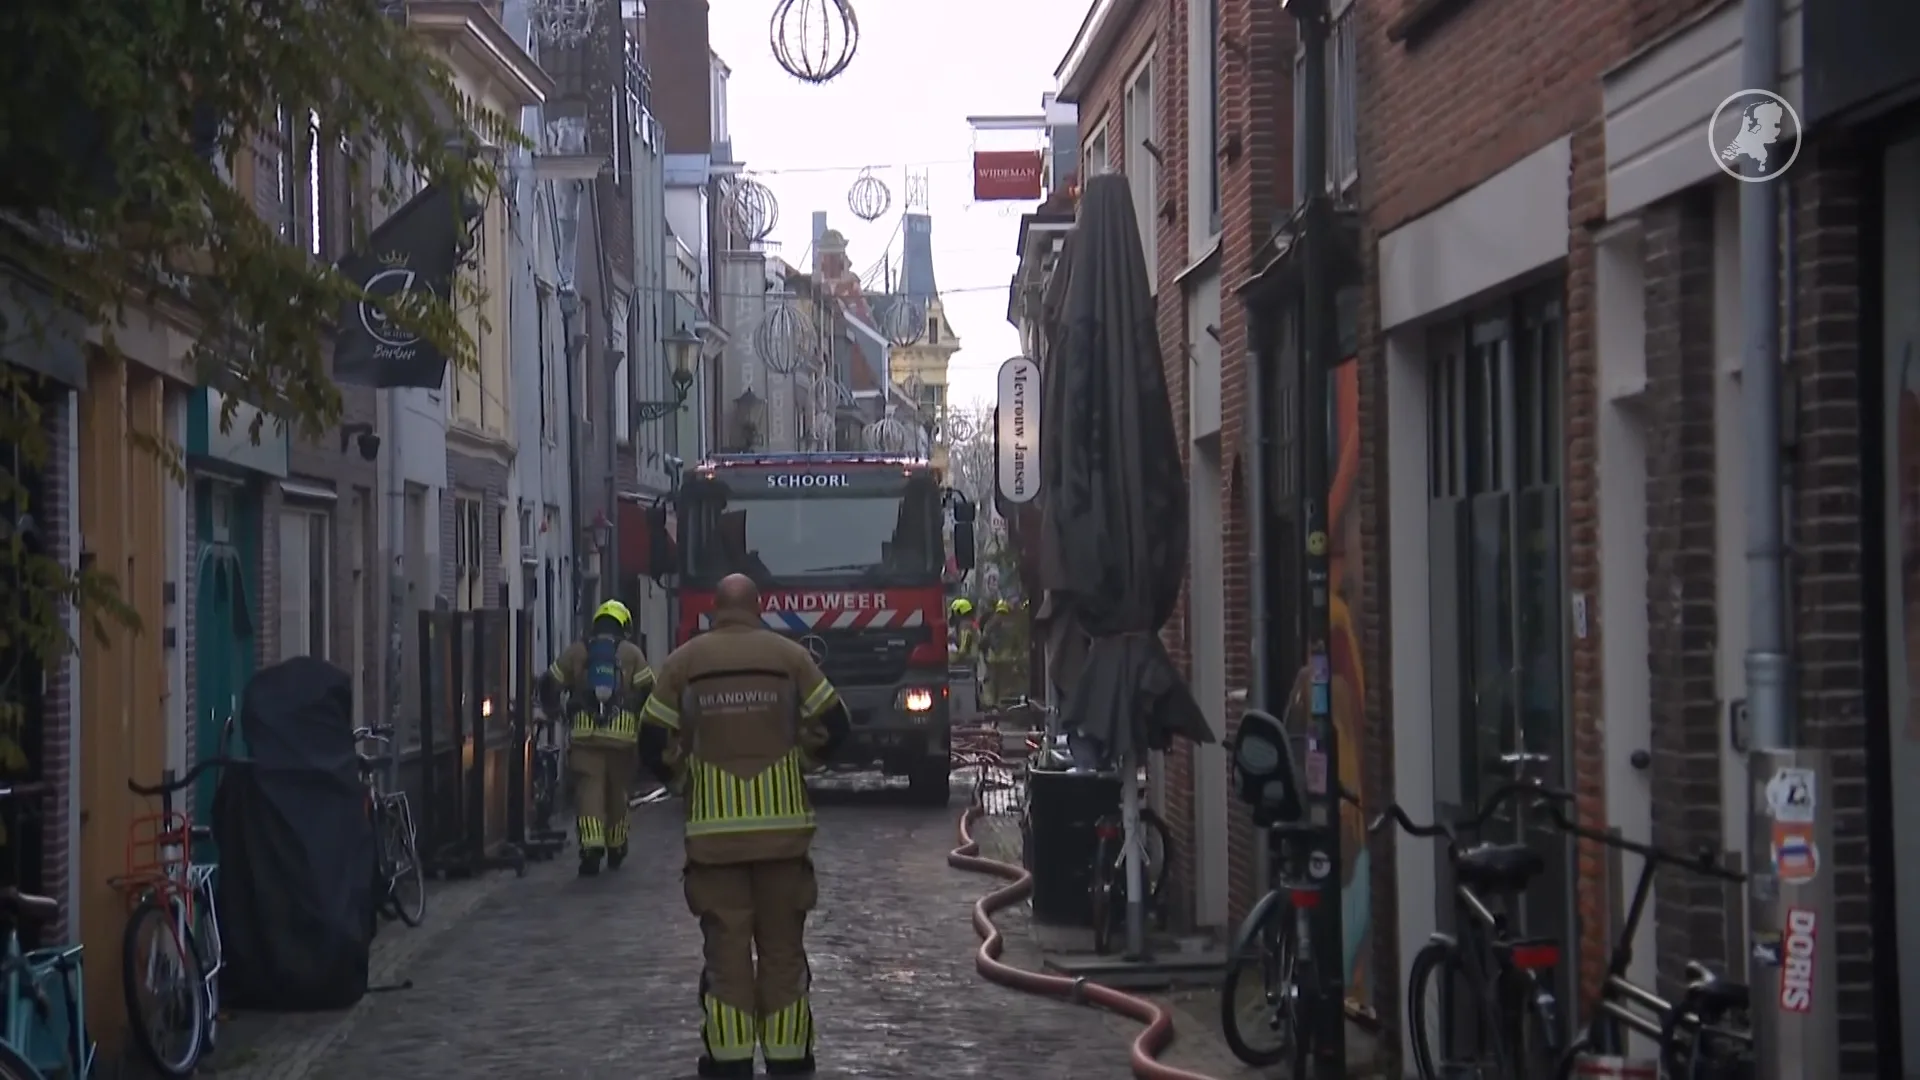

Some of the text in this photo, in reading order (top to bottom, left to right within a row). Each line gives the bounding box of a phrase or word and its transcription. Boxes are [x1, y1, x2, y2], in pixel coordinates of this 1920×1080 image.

[979, 167, 1036, 178] WIJDEMAN
[1014, 365, 1028, 496] Mevrouw Jansen
[767, 474, 850, 488] SCHOORL
[758, 592, 887, 611] ANDWEER
[1782, 909, 1816, 1009] DORIS
